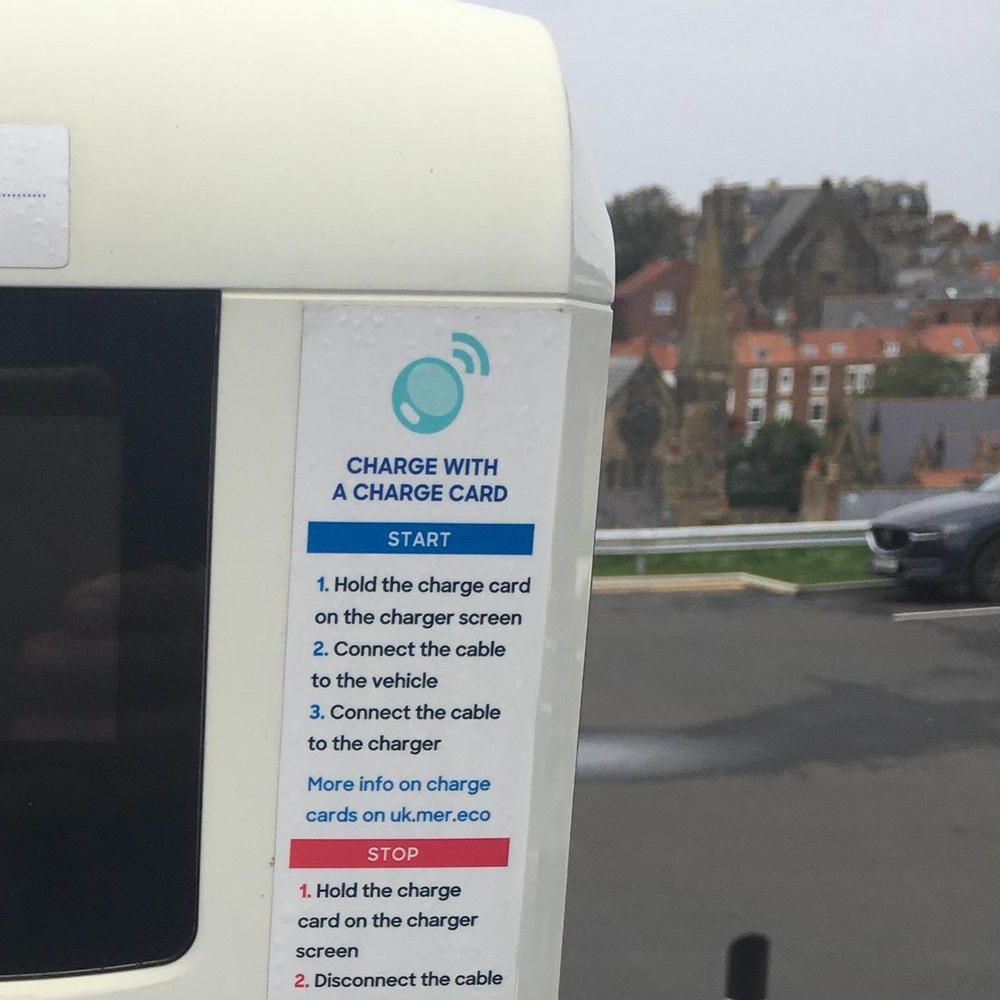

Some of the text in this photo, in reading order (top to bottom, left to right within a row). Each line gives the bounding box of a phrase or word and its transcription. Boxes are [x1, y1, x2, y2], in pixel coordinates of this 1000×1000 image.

[347, 457, 498, 476] CHARGE WITH
[332, 483, 508, 502] A CHARGE CARD
[388, 531, 451, 547] START
[315, 608, 522, 629] on the charger screen
[311, 672, 438, 688] to the vehicle
[308, 776, 491, 795] More info on charge
[306, 806, 491, 822] cards on uk.mer.eco
[368, 847, 419, 861] STOP
[298, 912, 479, 931] card on the charger
[296, 947, 359, 958] screen
